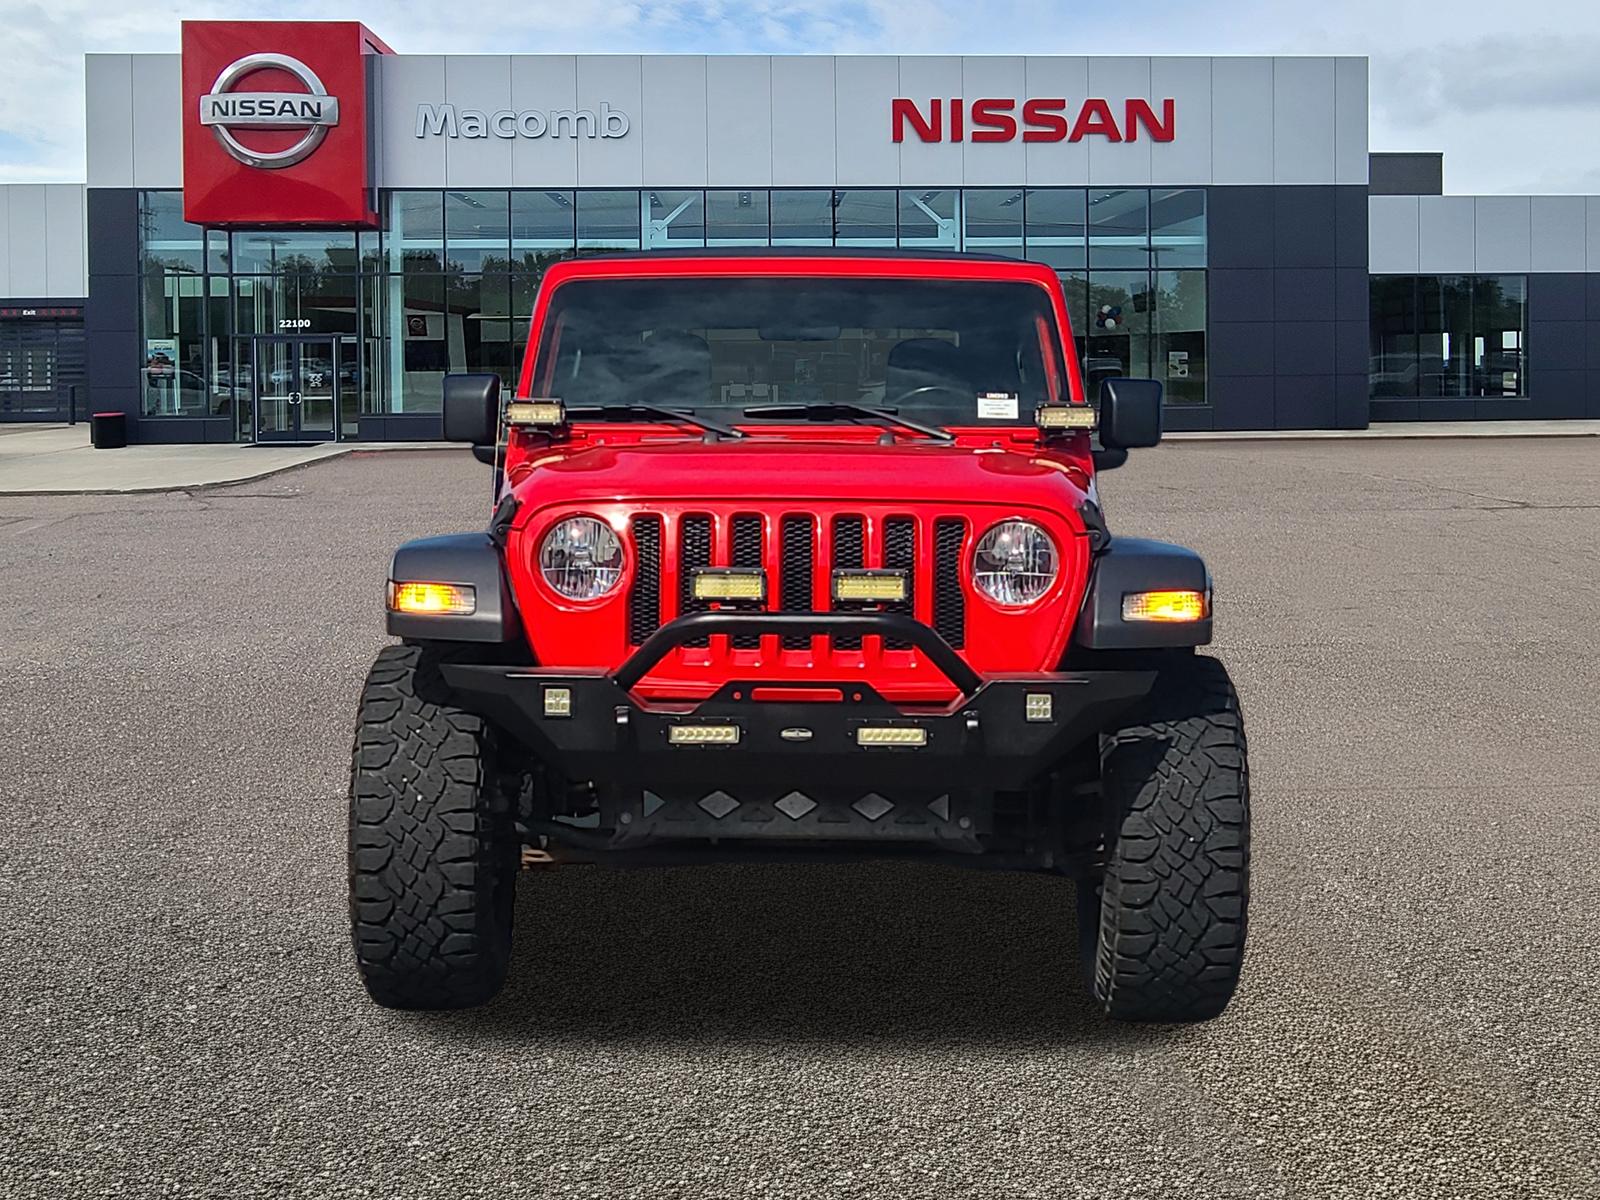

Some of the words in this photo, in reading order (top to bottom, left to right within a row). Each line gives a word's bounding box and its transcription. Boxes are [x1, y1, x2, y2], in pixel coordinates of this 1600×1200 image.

[211, 100, 321, 117] NISSAN
[415, 102, 630, 139] Macomb
[891, 98, 1175, 143] NISSAN
[279, 319, 311, 328] 22100
